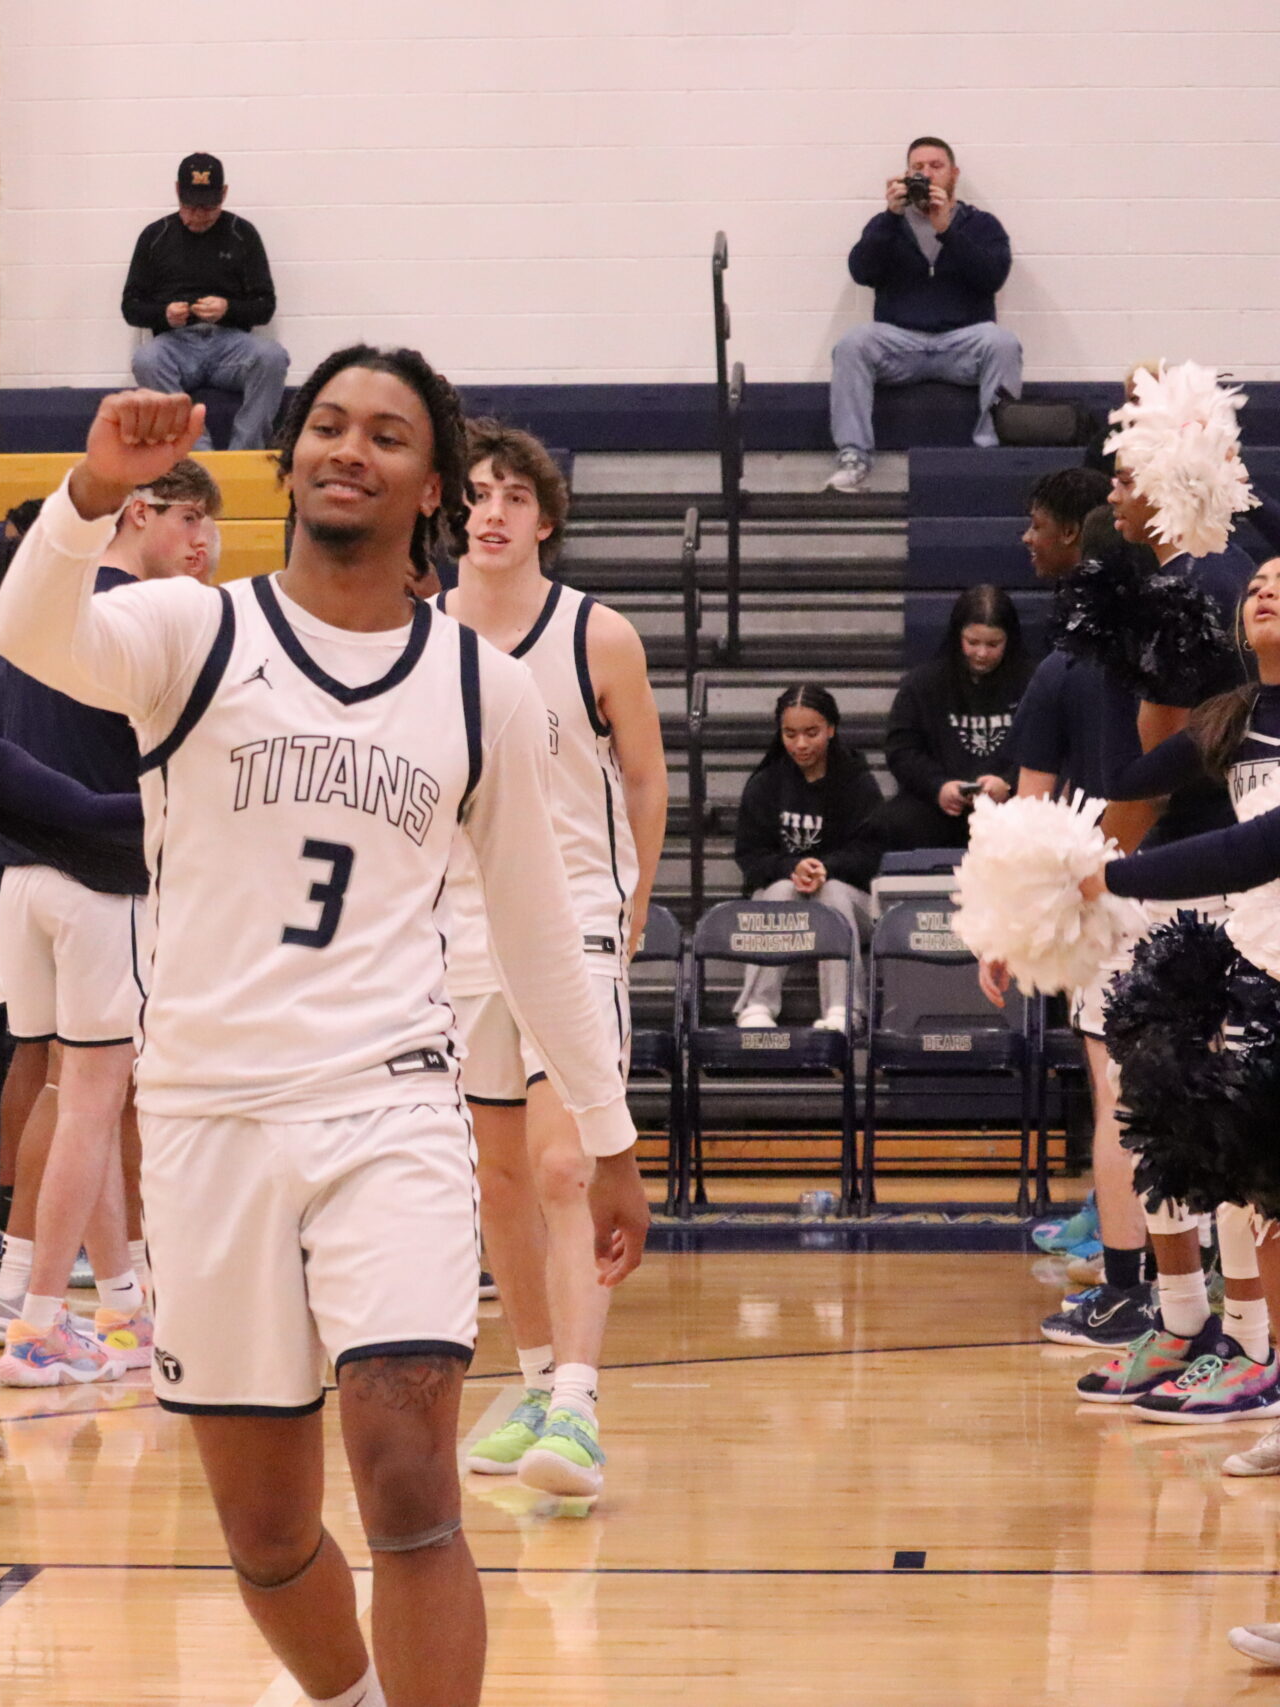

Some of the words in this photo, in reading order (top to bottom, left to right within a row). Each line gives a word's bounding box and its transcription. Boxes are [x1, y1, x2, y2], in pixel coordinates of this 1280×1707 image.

[191, 170, 211, 185] M
[230, 734, 440, 848] TITANS
[280, 836, 356, 950] 3
[737, 912, 810, 932] WILLIAM
[730, 932, 816, 952] CHRISMAN
[910, 931, 971, 951] CHRIS
[741, 1032, 791, 1050] BEARS
[922, 1034, 972, 1052] BEARS
[427, 1053, 440, 1065] M
